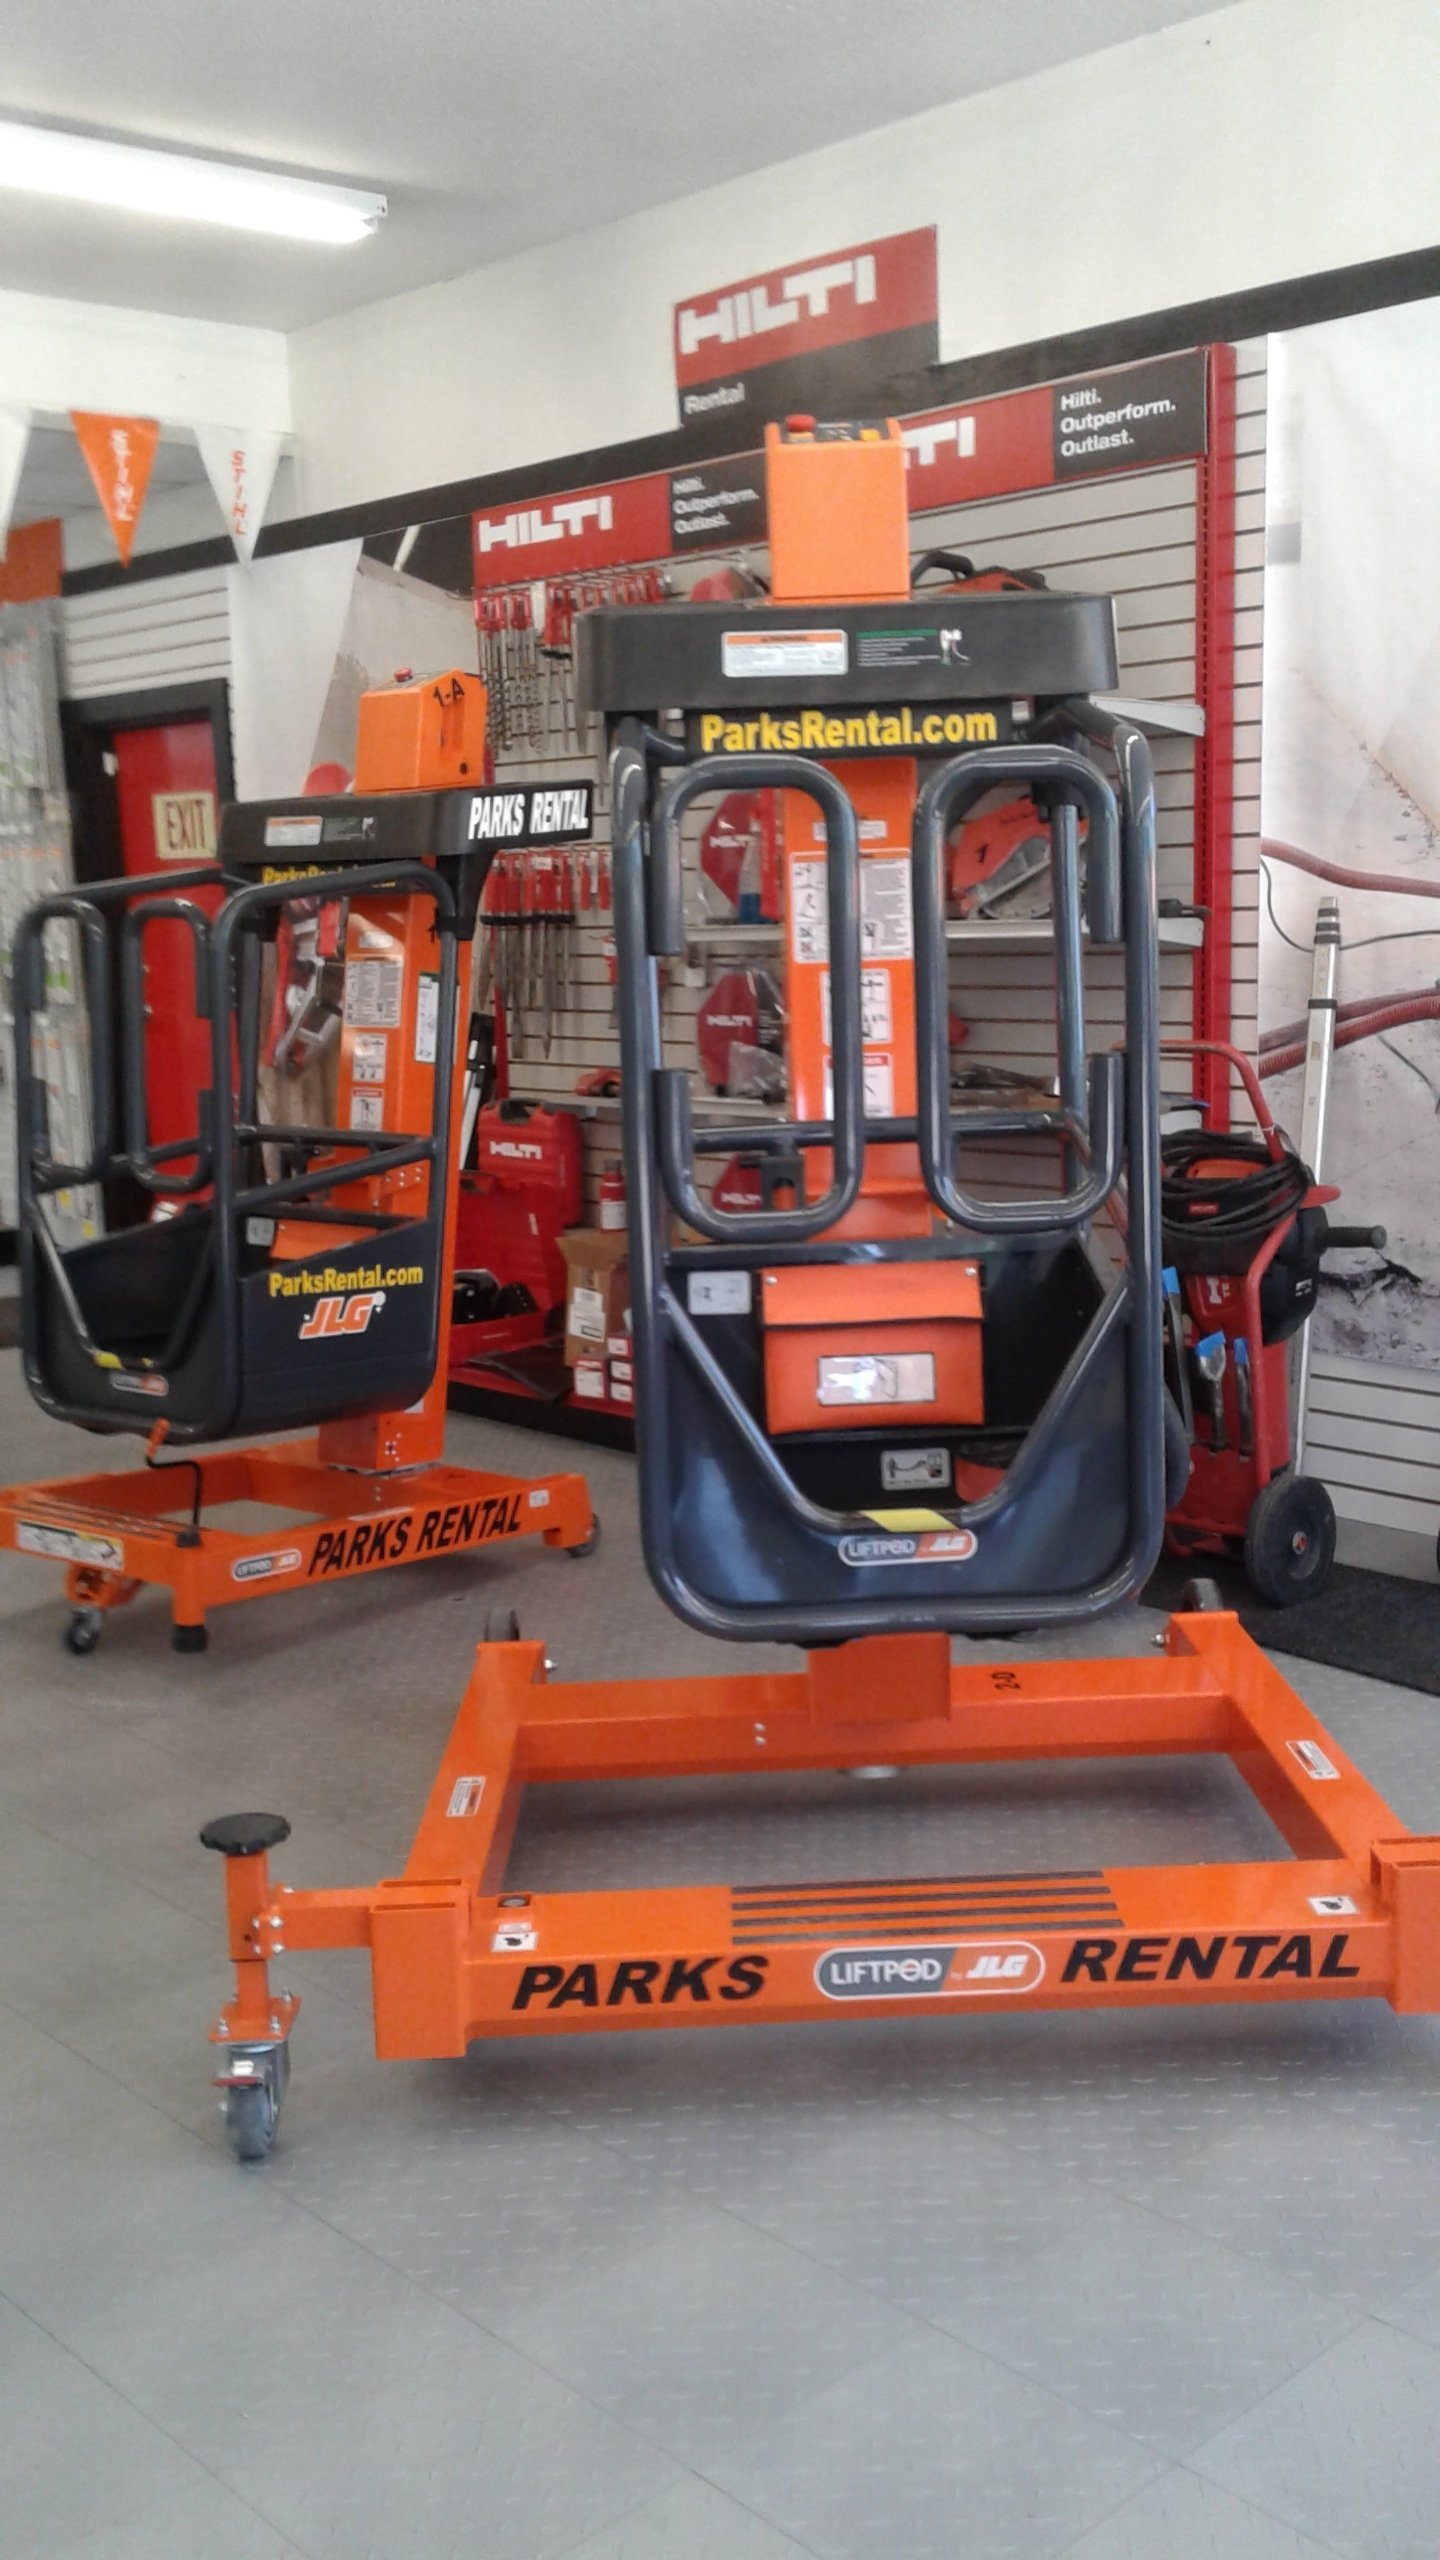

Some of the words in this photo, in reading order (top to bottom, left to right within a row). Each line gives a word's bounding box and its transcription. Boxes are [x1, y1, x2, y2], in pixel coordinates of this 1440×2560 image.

[680, 254, 876, 355] HILTI
[684, 382, 745, 415] Rental
[1060, 399, 1176, 434] Outperform.
[1061, 388, 1102, 412] Hilti.
[1060, 429, 1134, 457] Outlast.
[231, 450, 248, 536] STIHL
[479, 496, 612, 552] HILTI
[700, 707, 998, 752] ParksRental.com
[164, 799, 206, 850] EXIT
[468, 793, 525, 840] PARKS
[529, 789, 589, 834] RENTAL
[489, 1141, 542, 1160] HILTI
[268, 1264, 423, 1297] ParksRental.com
[299, 1294, 375, 1339] JLG
[308, 1516, 412, 1576] PARKS
[416, 1494, 522, 1552] RENTAL
[830, 1958, 942, 1985] LIFTPOD
[966, 1954, 1029, 1979] JLG
[1060, 1934, 1361, 1983] RENTAL
[511, 1955, 769, 2011] PARKS
